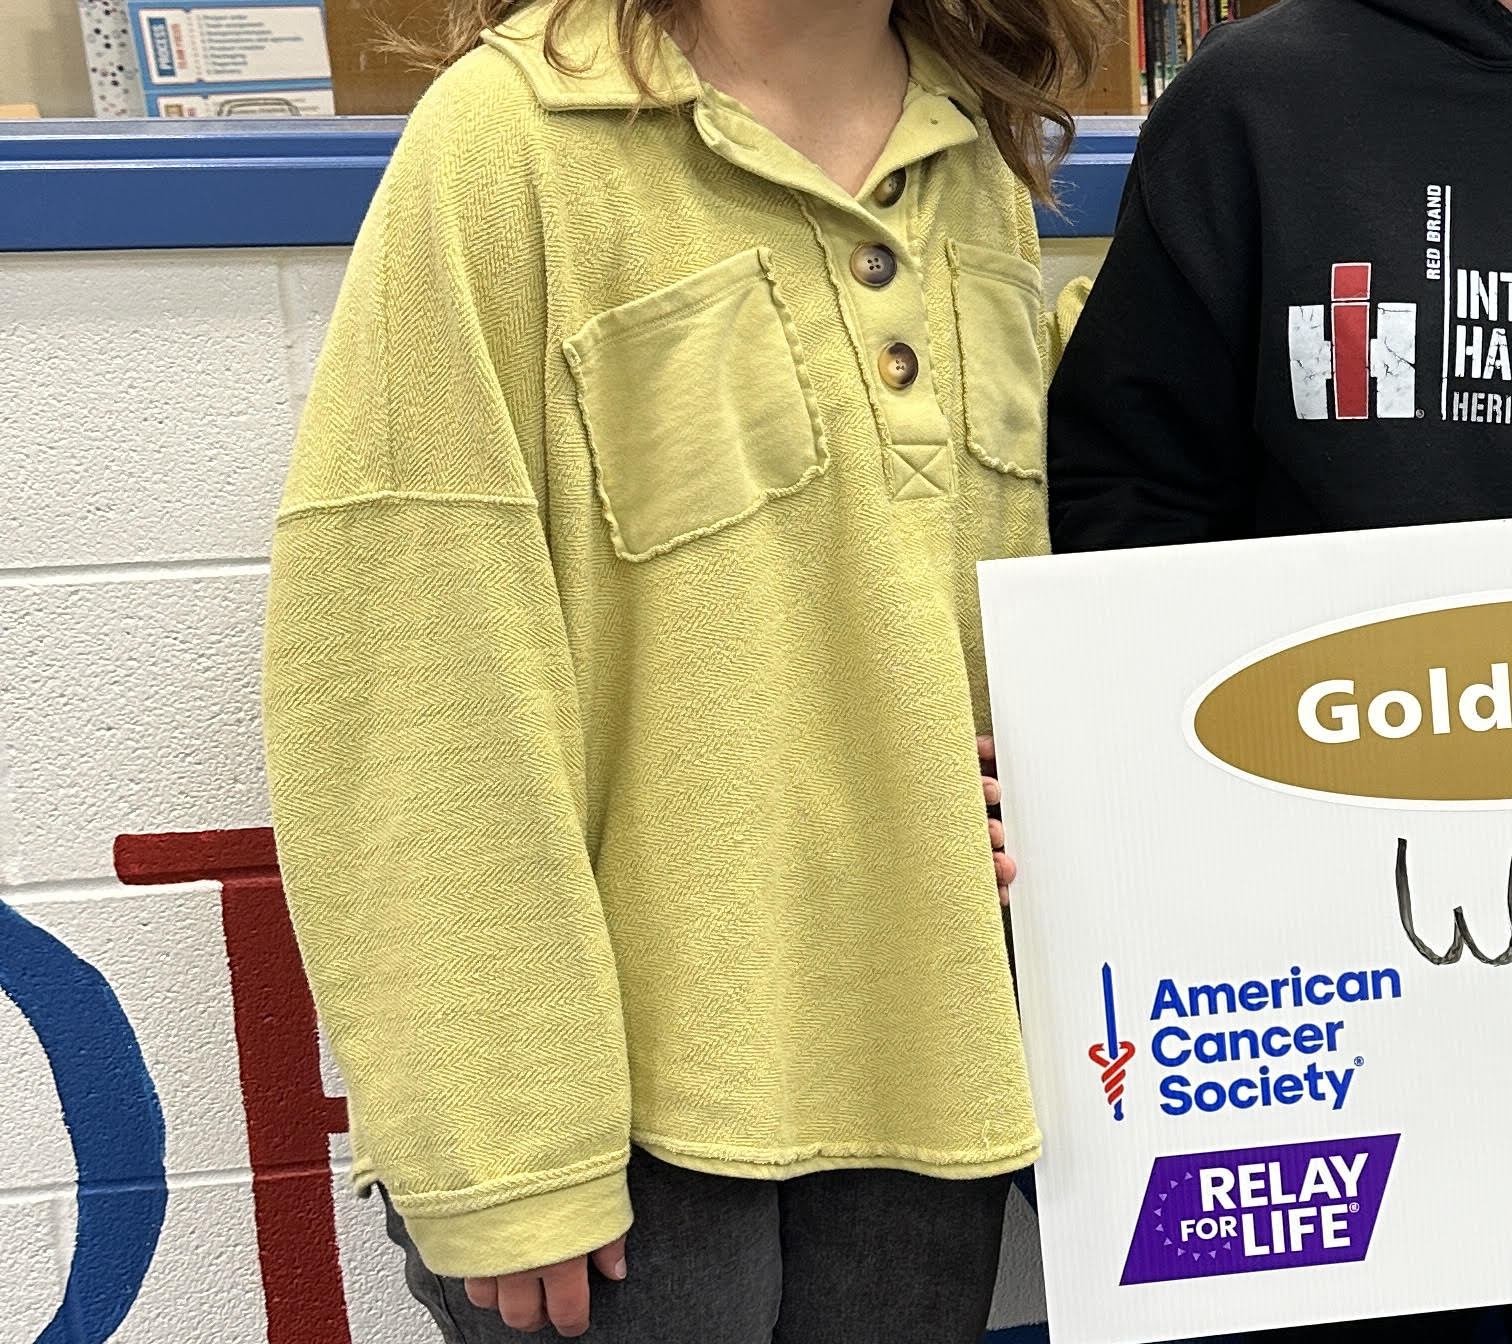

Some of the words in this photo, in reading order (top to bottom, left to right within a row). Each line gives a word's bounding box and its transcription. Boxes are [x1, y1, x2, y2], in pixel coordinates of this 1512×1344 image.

[1426, 184, 1442, 242] BRAND
[1426, 248, 1441, 280] RED
[1298, 662, 1512, 744] Gold
[1150, 965, 1402, 1021] American
[1151, 1020, 1345, 1068] Cancer
[1199, 1152, 1369, 1212] RELAY
[1180, 1215, 1238, 1242] FOR
